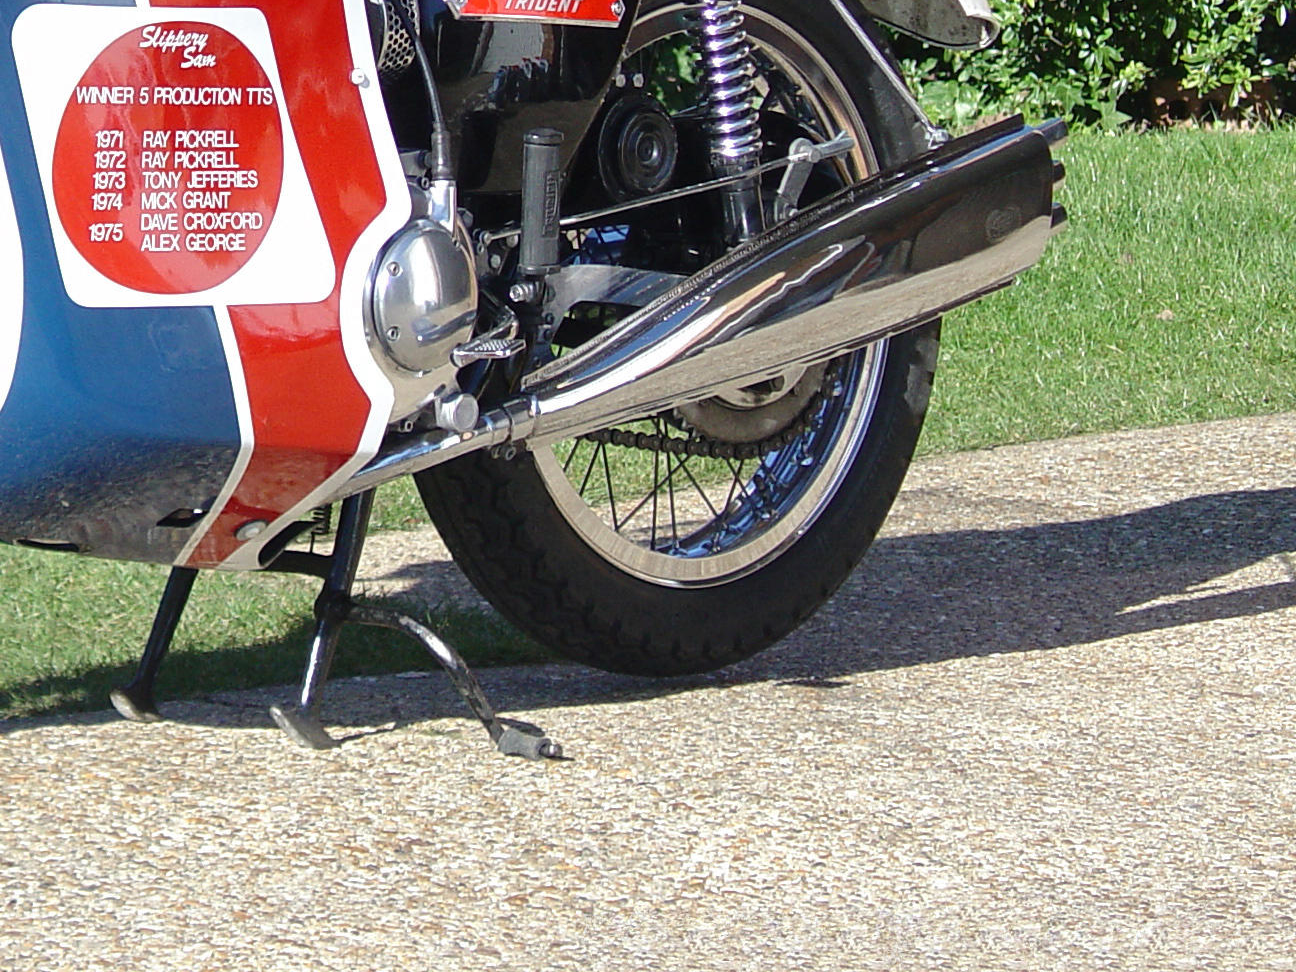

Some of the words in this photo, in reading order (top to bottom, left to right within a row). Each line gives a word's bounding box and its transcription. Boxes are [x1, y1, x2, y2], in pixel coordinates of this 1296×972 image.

[140, 25, 208, 53] Slippery
[181, 46, 217, 69] Sam
[76, 86, 134, 105] WINNER
[139, 86, 149, 105] 5
[154, 87, 241, 106] PRODUCTION
[247, 87, 273, 106] TTS
[95, 130, 124, 148] 1971
[142, 130, 171, 148] RAY
[175, 130, 240, 148] PICKRELL
[94, 151, 126, 169] 1972
[141, 151, 170, 169] RAY
[174, 151, 240, 169] PICKRELL
[93, 171, 126, 190] 1973
[142, 171, 182, 189] TONY
[186, 170, 259, 189] JEFFERIES
[91, 193, 123, 210] 1974
[141, 192, 178, 210] MICK
[182, 191, 231, 210] GRANT
[140, 213, 178, 231] DAVE
[183, 212, 263, 230] CROXFORD
[89, 223, 123, 242] 1975
[140, 234, 180, 252] ALEX
[185, 233, 246, 252] GEORGE
